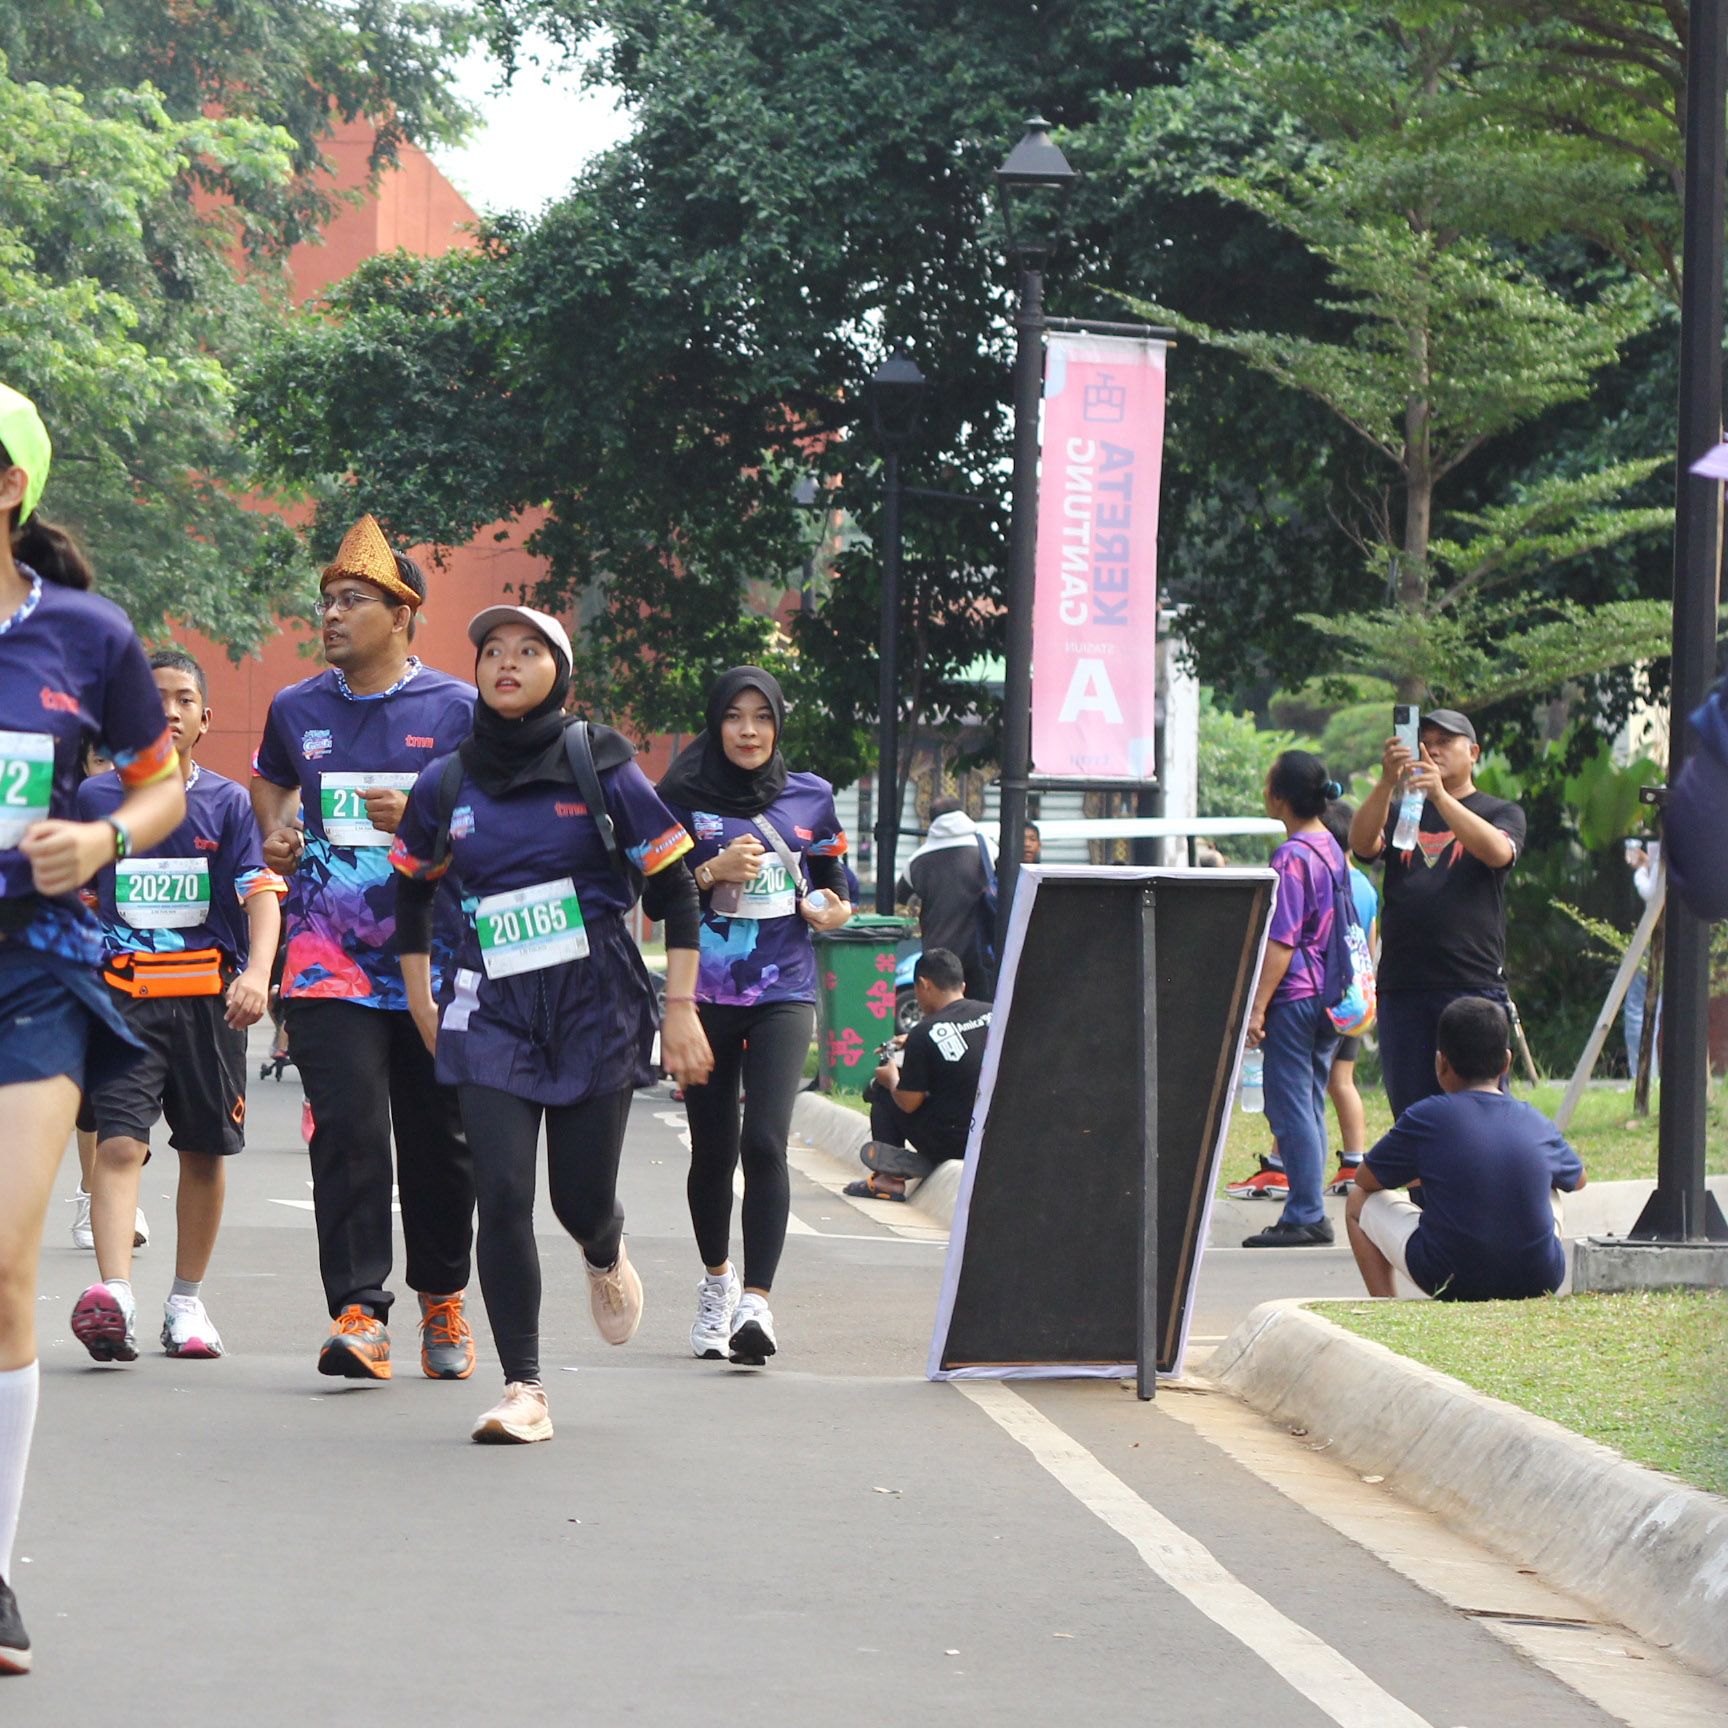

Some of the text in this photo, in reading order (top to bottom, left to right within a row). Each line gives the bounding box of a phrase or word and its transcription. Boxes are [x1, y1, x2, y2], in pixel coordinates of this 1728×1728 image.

[129, 874, 198, 902] 20270
[743, 866, 786, 894] 0200
[489, 899, 568, 946] 20165
